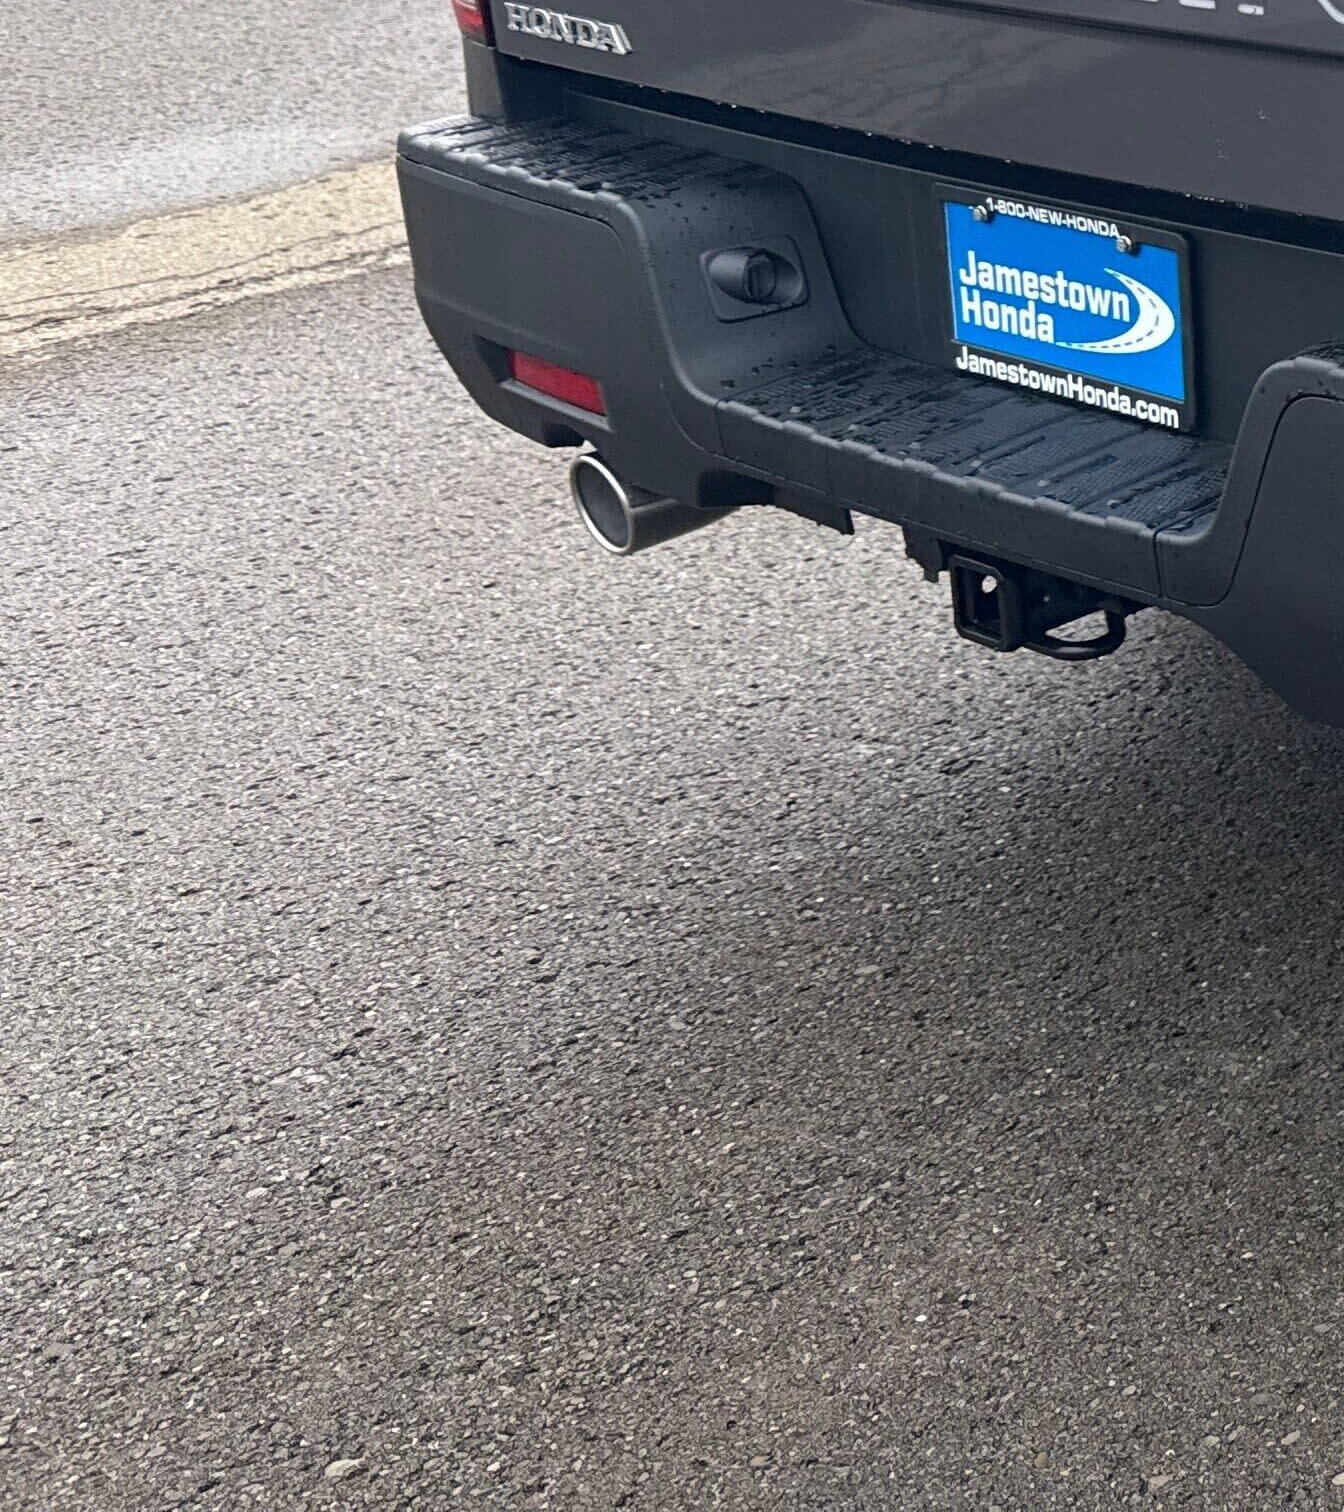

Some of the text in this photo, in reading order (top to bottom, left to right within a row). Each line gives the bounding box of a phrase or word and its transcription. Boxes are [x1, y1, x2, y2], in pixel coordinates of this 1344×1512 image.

[503, 1, 633, 56] HONDA
[986, 197, 1120, 239] 1-800-NEW-HONDA
[959, 250, 1130, 323] Jamestown
[960, 286, 1054, 344] Honda
[955, 346, 1180, 429] JamestownHonda.com
